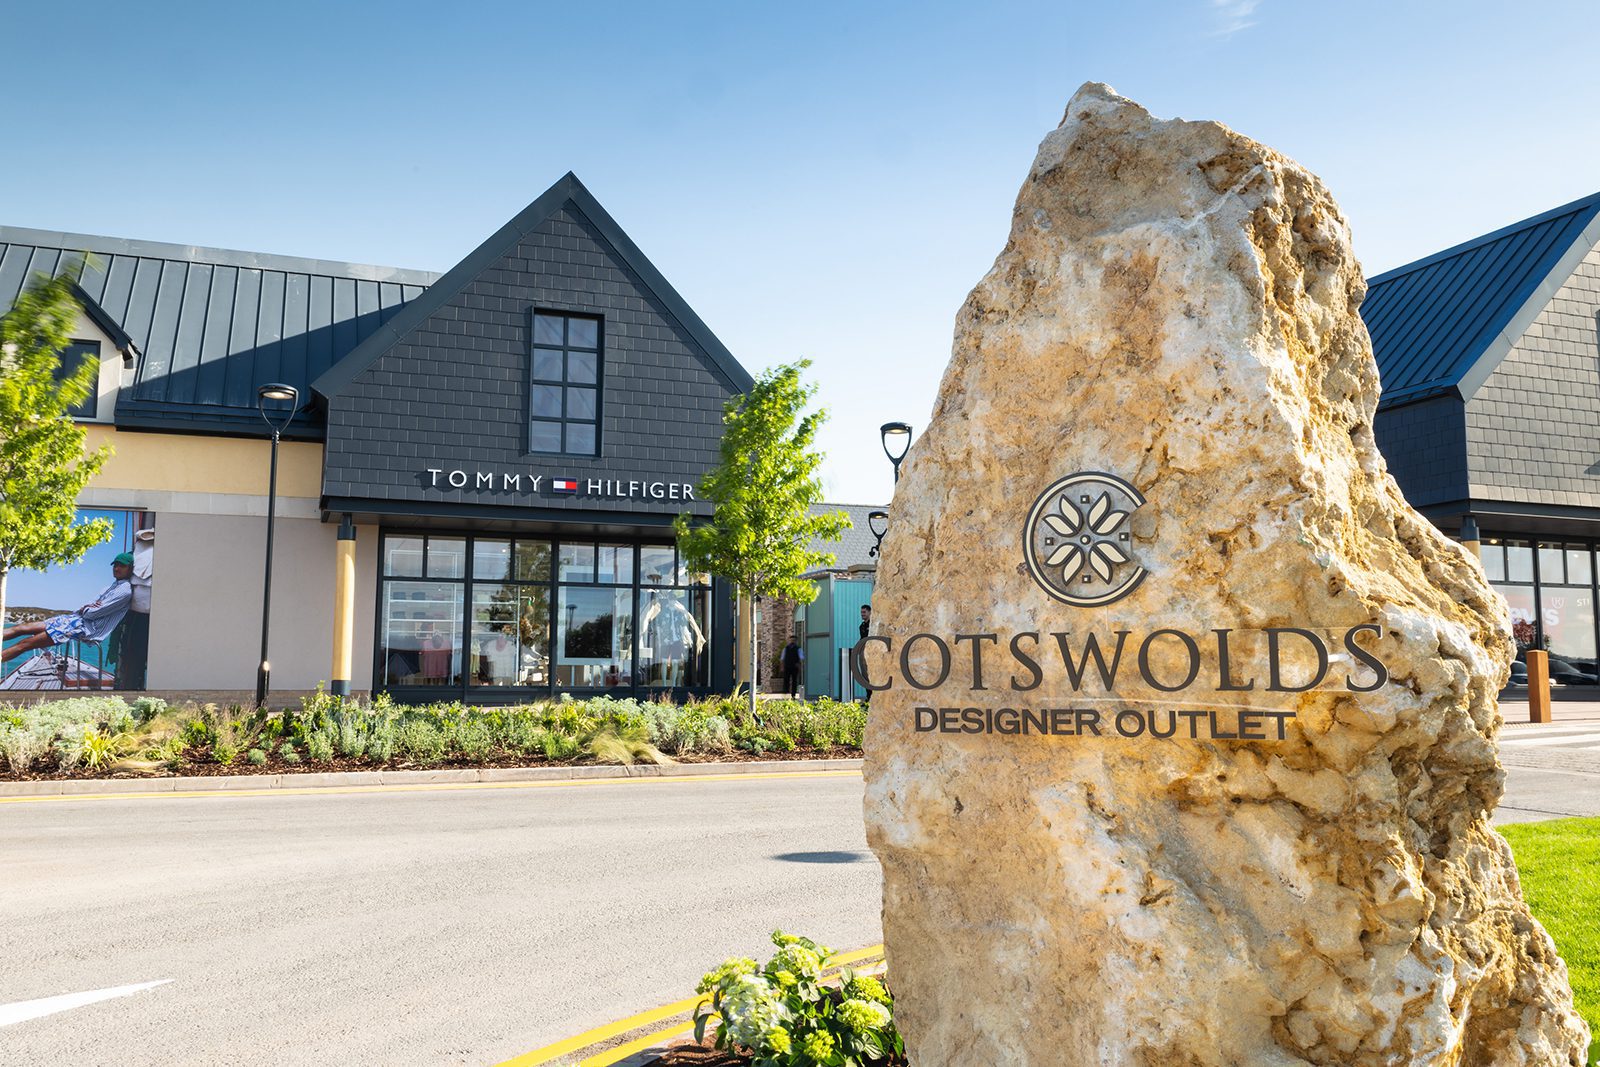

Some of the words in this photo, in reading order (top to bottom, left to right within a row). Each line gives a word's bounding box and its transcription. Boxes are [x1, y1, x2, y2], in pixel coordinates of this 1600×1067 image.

[427, 468, 543, 492] TOMMY
[587, 478, 695, 500] HILFIGER
[850, 624, 1389, 692] COTSWOLDS
[915, 707, 1102, 736] DESIGNER
[1115, 710, 1297, 740] OUTLET
